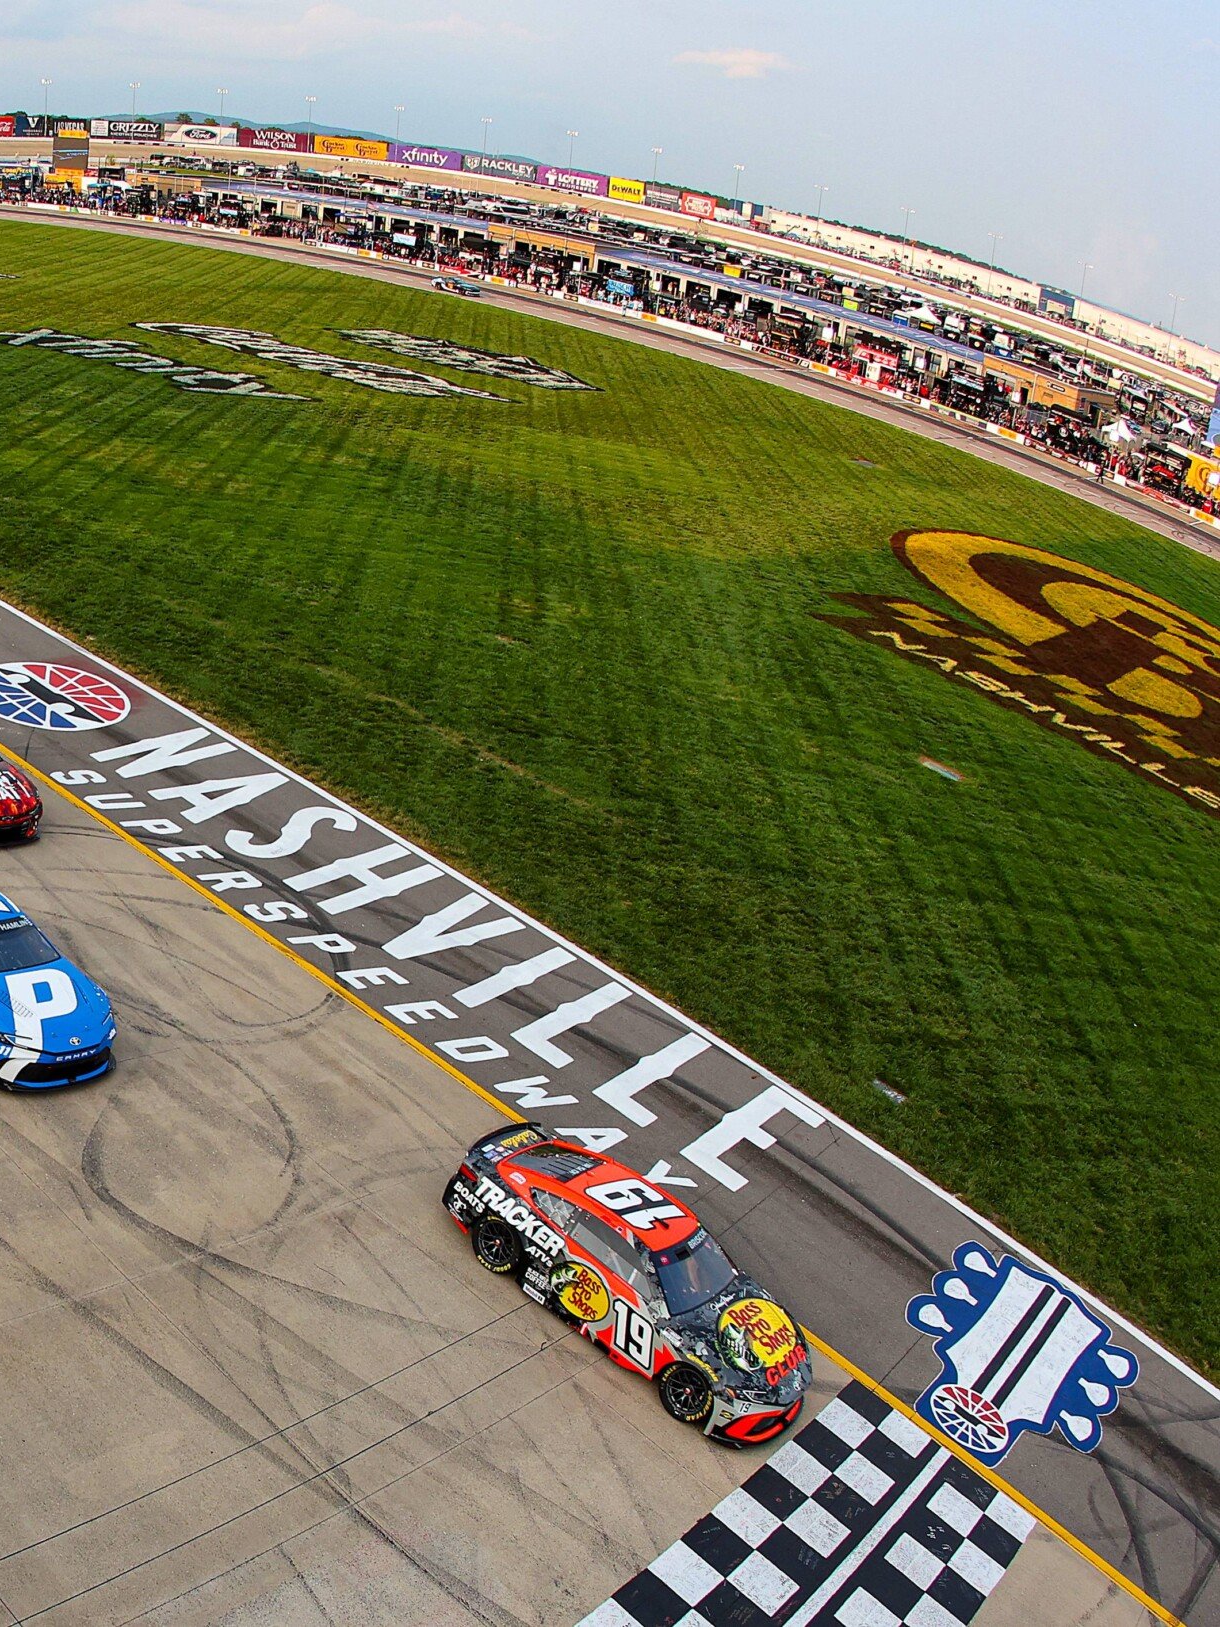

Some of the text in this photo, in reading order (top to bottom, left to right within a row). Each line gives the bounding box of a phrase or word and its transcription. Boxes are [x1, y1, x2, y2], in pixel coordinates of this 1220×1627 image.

[109, 122, 159, 133] GRIZZLY
[189, 129, 211, 139] Ford
[254, 130, 296, 143] WILSON
[253, 139, 269, 147] Bank
[280, 141, 297, 149] Trust
[402, 148, 448, 167] xfinity
[482, 158, 534, 174] RACKLEY
[558, 173, 598, 189] LOTTERY
[0, 918, 29, 931] HAMLIN
[90, 727, 827, 1193] NASHVILLE
[50, 768, 698, 1188] SUPERSPEEDWAY
[4, 968, 78, 1051] P
[56, 1048, 98, 1062] CAMRY
[453, 1180, 486, 1214] BOATS
[475, 1176, 565, 1257] TRACKER
[525, 1245, 554, 1268] ATVs
[525, 1271, 547, 1291] COFFEE
[572, 1283, 592, 1301] Pro
[577, 1269, 602, 1295] Bass
[568, 1292, 598, 1320] Shops
[728, 1301, 763, 1327] Bass
[613, 1298, 654, 1369] 19
[745, 1318, 772, 1340] Pro
[759, 1324, 796, 1357] Shops
[765, 1344, 807, 1387] CLUB
[739, 1402, 752, 1414] 19
